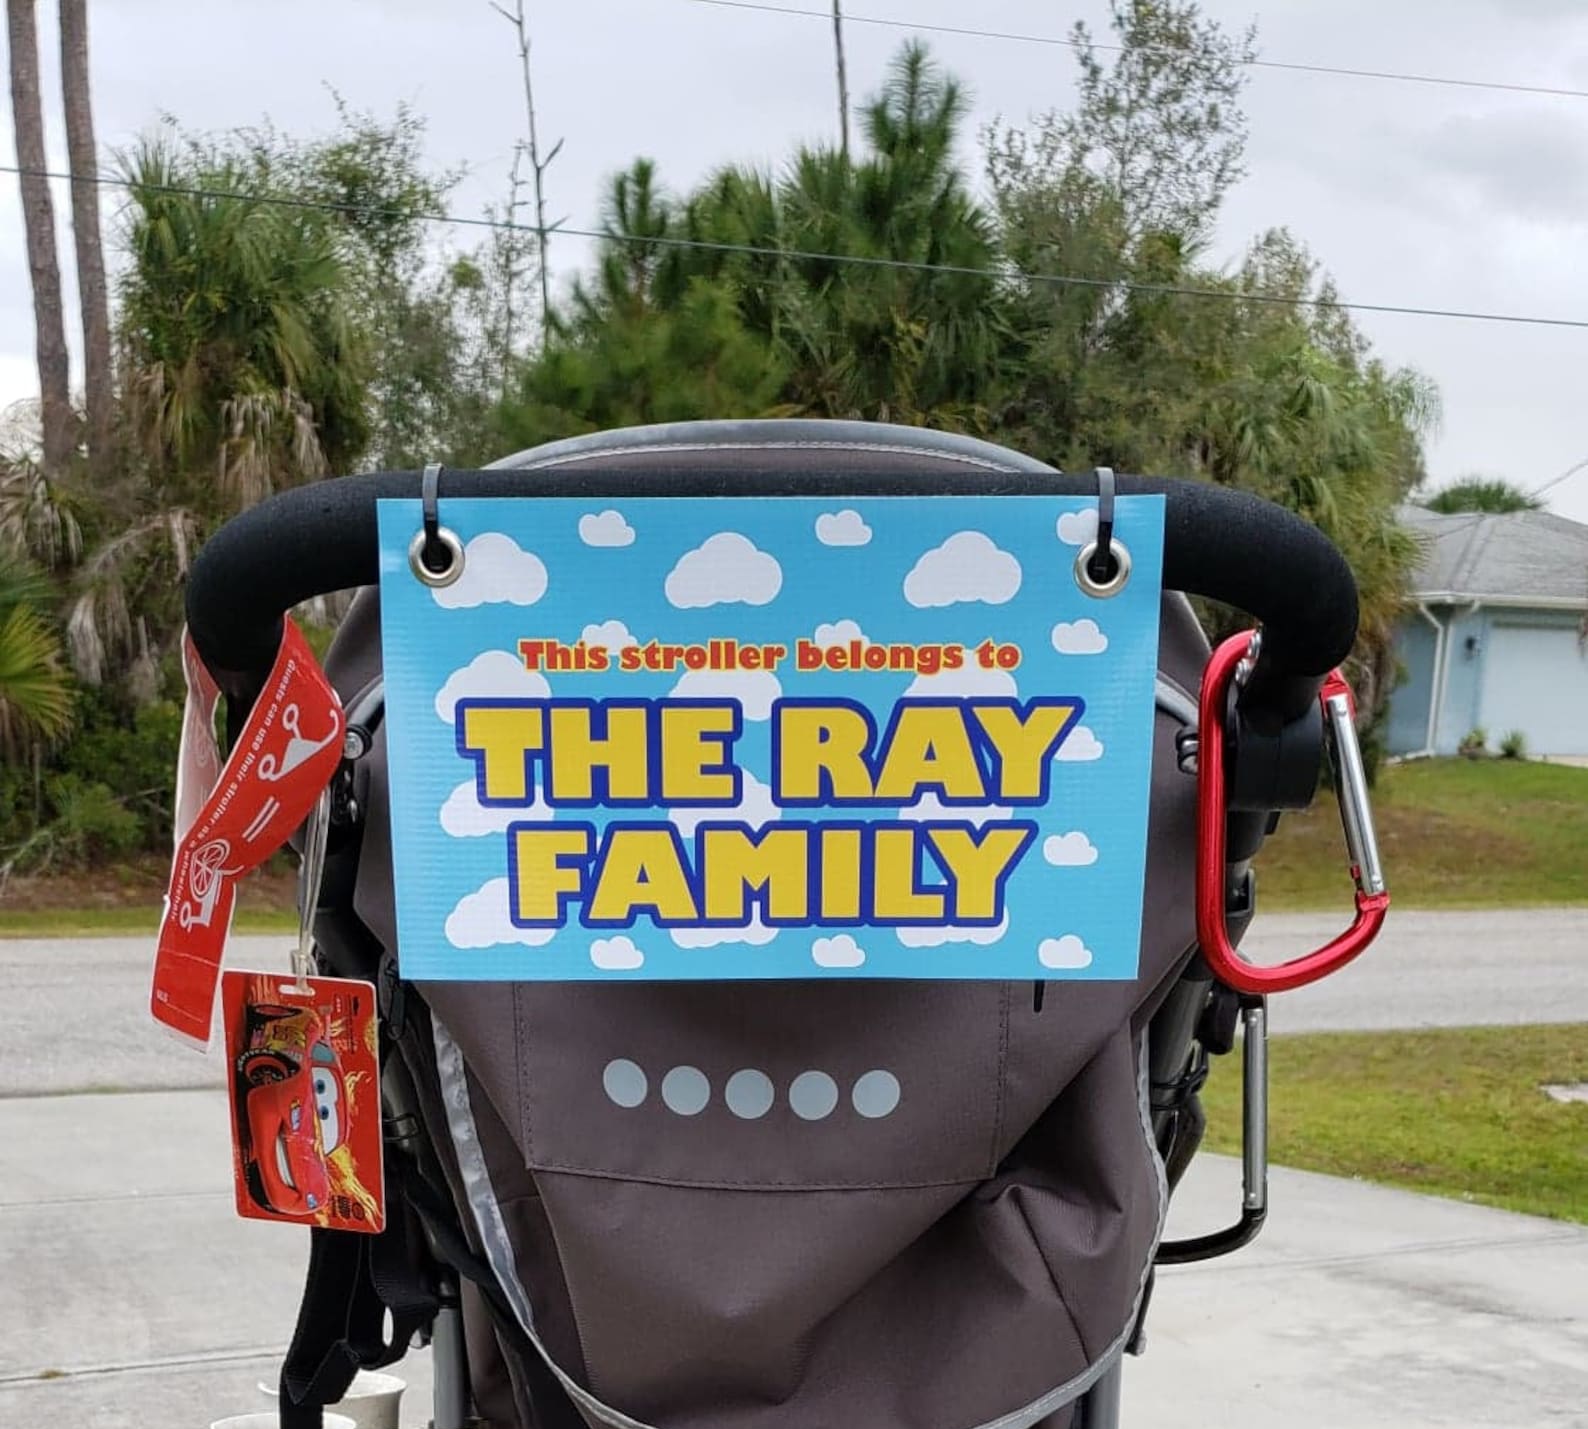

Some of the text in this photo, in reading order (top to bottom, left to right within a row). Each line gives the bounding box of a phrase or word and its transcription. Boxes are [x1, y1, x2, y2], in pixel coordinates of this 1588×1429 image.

[518, 637, 1021, 676] This stroller belongs to
[275, 659, 296, 702] Guests
[263, 703, 278, 727] can
[252, 727, 267, 751] use
[456, 697, 1085, 808] THE RAY
[235, 752, 255, 781] their
[210, 782, 238, 825] stroller
[197, 825, 210, 839] as
[508, 821, 1038, 928] FAMILY
